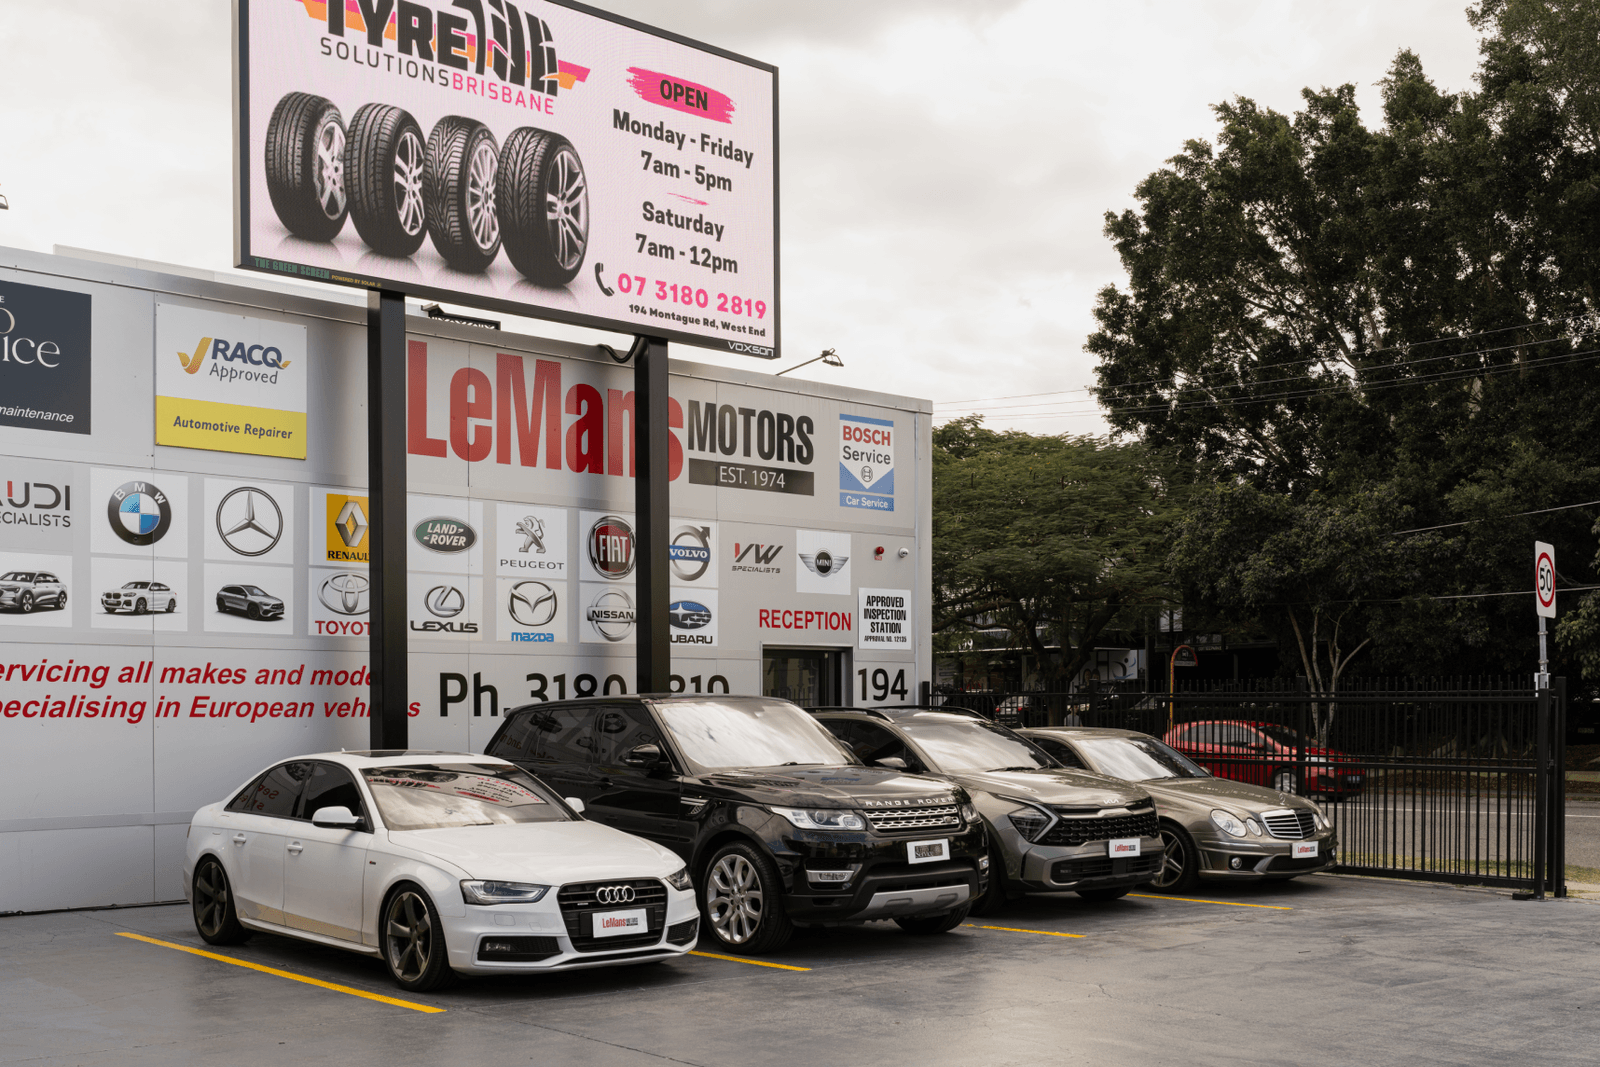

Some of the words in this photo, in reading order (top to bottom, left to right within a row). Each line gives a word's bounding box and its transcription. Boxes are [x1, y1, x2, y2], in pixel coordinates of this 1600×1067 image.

[660, 79, 708, 111] OPEN
[613, 108, 686, 151] Monday
[700, 132, 754, 169] Friday
[641, 150, 680, 179] 7am
[695, 164, 732, 192] 5pm
[642, 201, 724, 242] Saturday
[635, 232, 675, 260] 7am
[690, 245, 738, 274] 12pm
[254, 257, 270, 269] THE
[272, 260, 298, 274] GREEN
[300, 265, 330, 279] SCREEN
[331, 274, 354, 283] POWERED
[617, 272, 647, 296] 07
[655, 279, 709, 308] 3180
[716, 292, 767, 319] 2819
[629, 304, 647, 315] 194
[649, 307, 701, 325] Montague
[702, 317, 719, 330] Rd,
[721, 321, 747, 334] West
[748, 326, 766, 337] End
[211, 338, 287, 370] RACQ
[209, 362, 278, 384] Approved
[173, 415, 240, 434] Automotive
[243, 423, 293, 440] Repairer
[688, 399, 814, 465] MOTORS
[843, 425, 891, 446] BOSCH
[843, 445, 891, 465] Service
[719, 465, 748, 486] EST.
[752, 469, 786, 489] 1974
[0, 480, 70, 511] UDI
[113, 482, 166, 505] BMW
[846, 495, 860, 506] Car
[861, 497, 889, 508] Service
[0, 511, 71, 528] CIALISTS
[427, 522, 457, 535] LAND
[430, 534, 466, 547] ROVER
[599, 535, 628, 563] FIAT
[328, 550, 370, 562] RENAUL
[500, 559, 564, 570] PEUGEOT
[669, 548, 708, 559] VOLVO
[734, 542, 783, 565] VW
[816, 559, 832, 567] MINI
[731, 565, 781, 574] SPECIALISTS
[1539, 567, 1553, 592] 50
[866, 595, 904, 608] APPROVED
[591, 610, 634, 619] NISSAN
[759, 608, 852, 631] RECEPTION
[863, 608, 907, 621] INSPECTION
[314, 620, 370, 636] TOYOT
[410, 620, 479, 634] LEXUS
[870, 621, 902, 634] STATION
[669, 634, 713, 644] UBARU
[118, 660, 153, 684] all
[159, 662, 247, 685] makes
[255, 664, 305, 686] and
[310, 665, 370, 686] mod
[857, 667, 909, 701] 194
[0, 694, 147, 724] ecialising
[155, 695, 181, 718] in
[189, 695, 315, 723] European
[864, 799, 911, 807] RANGE
[917, 797, 954, 805] ROVER
[602, 917, 626, 929] LeMans
